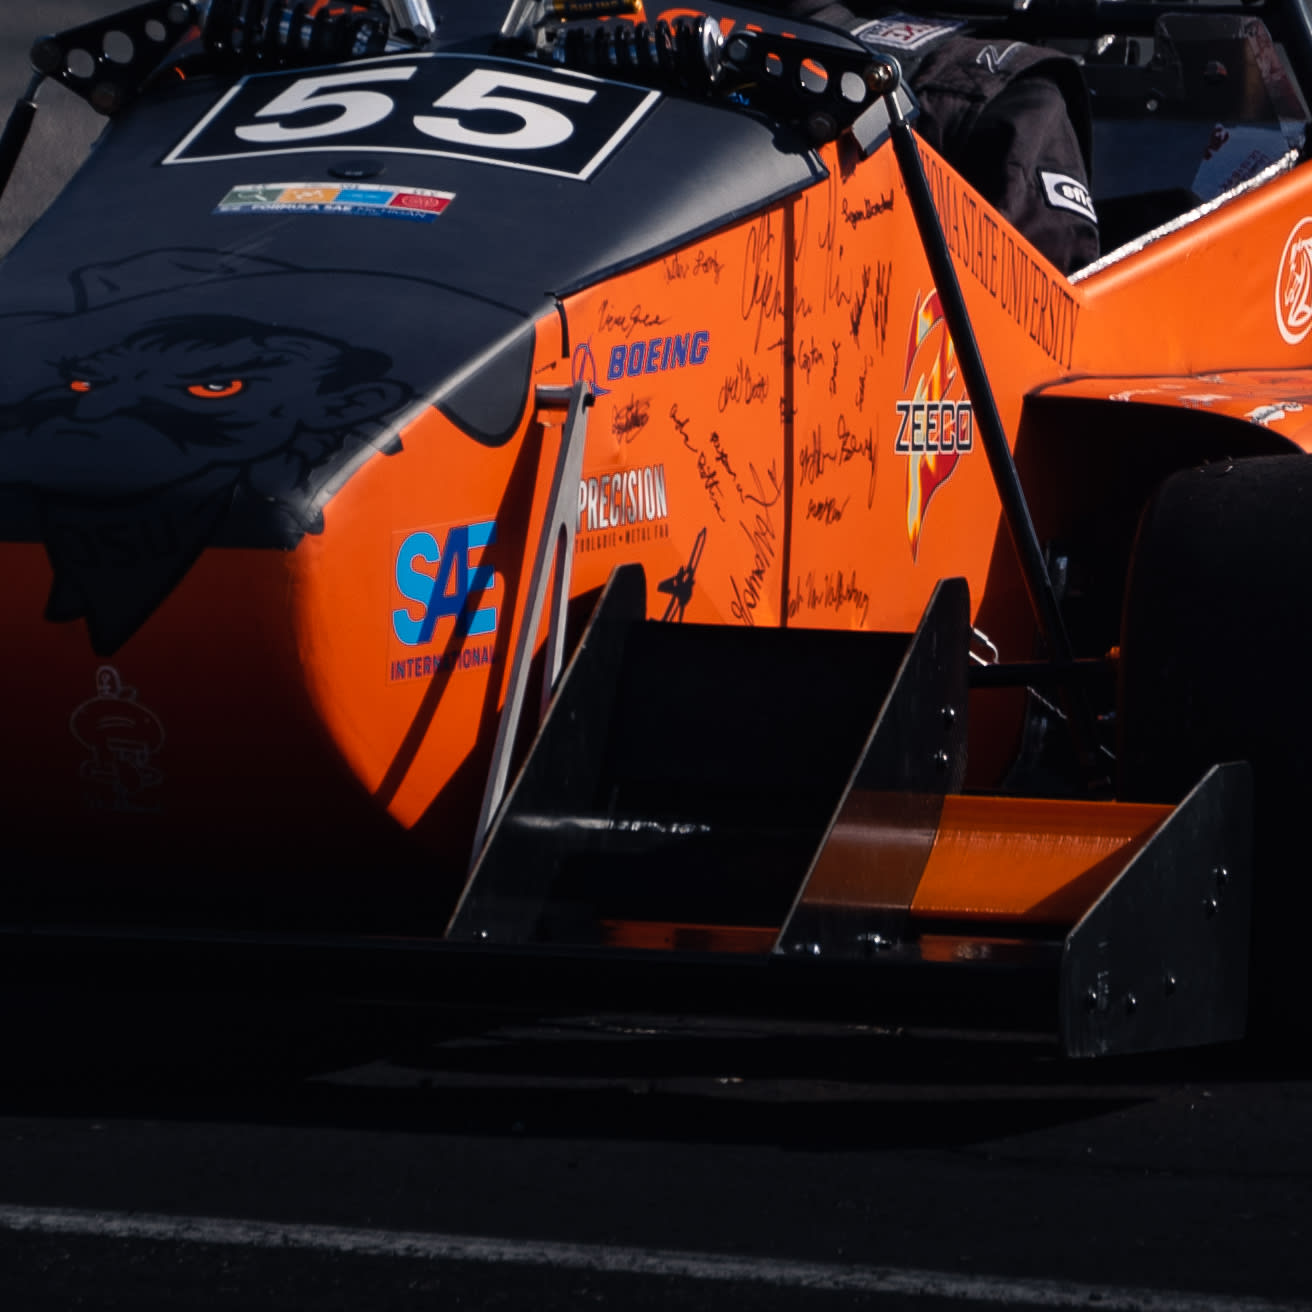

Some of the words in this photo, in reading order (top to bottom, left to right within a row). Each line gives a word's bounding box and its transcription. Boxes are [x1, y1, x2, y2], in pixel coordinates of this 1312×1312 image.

[234, 65, 597, 151] 55
[961, 191, 999, 300] STATE
[1000, 230, 1080, 371] UNIVERSITY
[607, 330, 710, 381] BOEING
[895, 400, 974, 456] ZEECO
[576, 463, 668, 534] PRECISION
[391, 520, 498, 646] SAE
[390, 645, 500, 681] INTERNATIONAL
